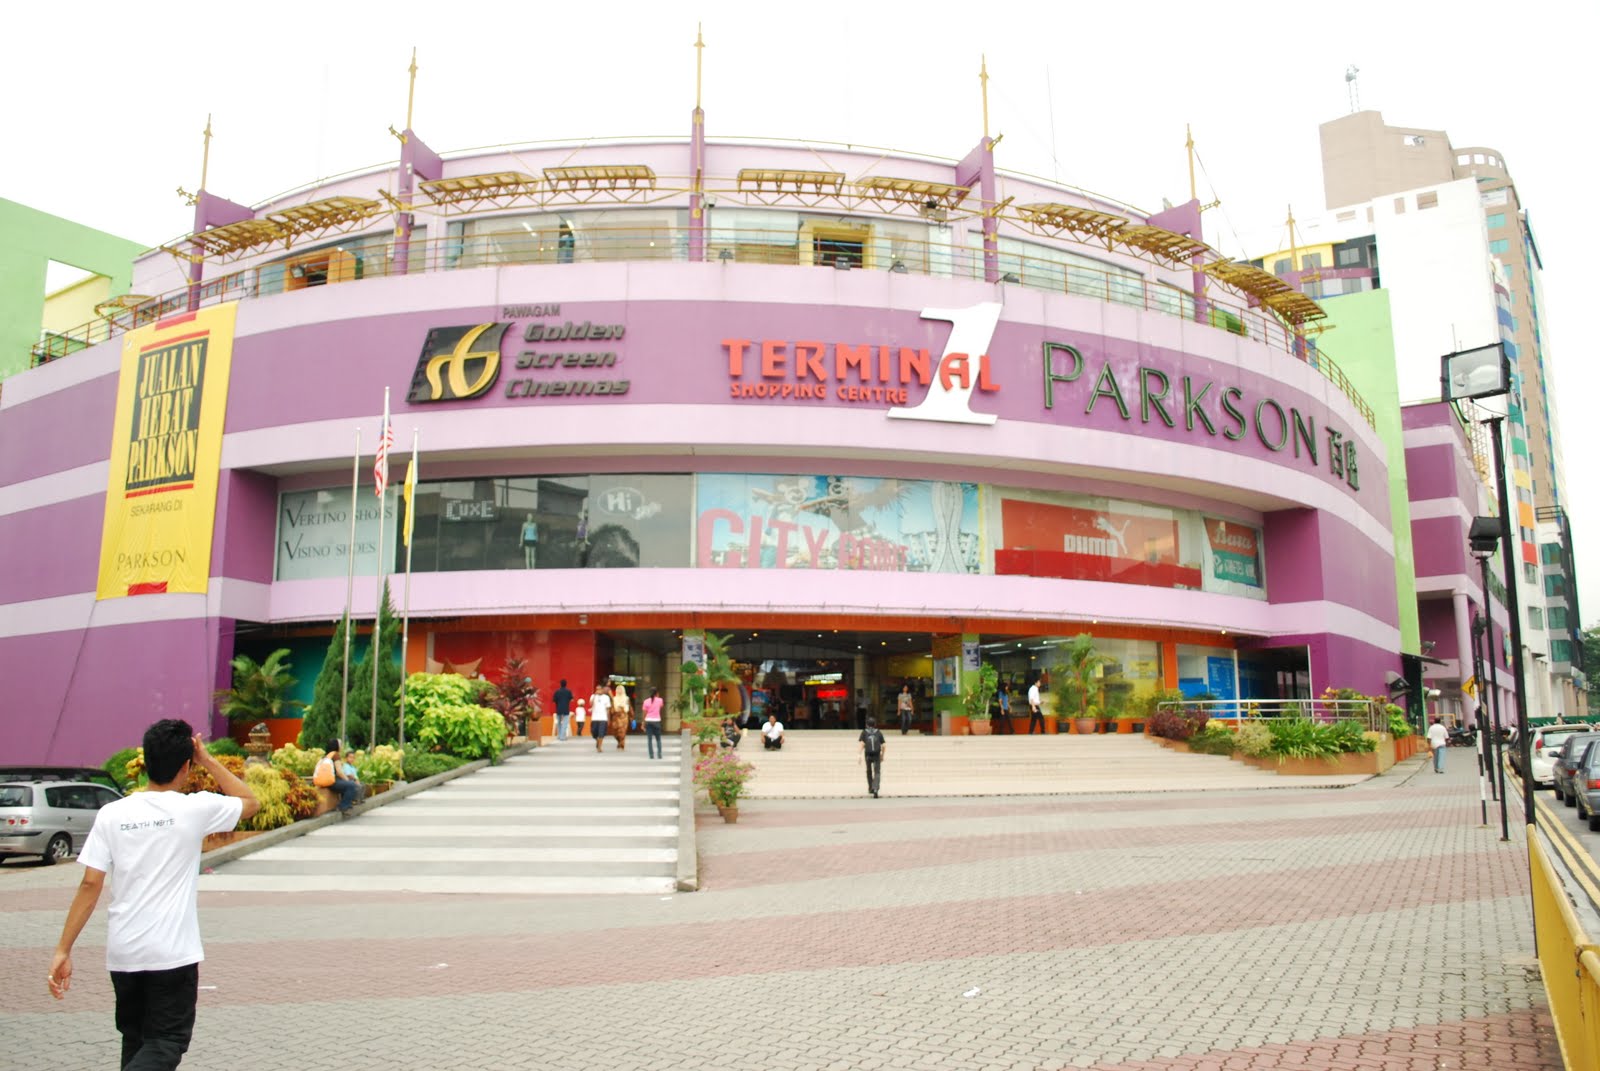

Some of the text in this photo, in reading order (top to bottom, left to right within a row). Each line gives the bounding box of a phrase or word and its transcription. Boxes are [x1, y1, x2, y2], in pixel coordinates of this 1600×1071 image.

[502, 304, 561, 319] PAWAGAM
[525, 321, 625, 342] Golden
[140, 343, 203, 400] JUALAN
[515, 350, 617, 369] Screen
[721, 338, 1001, 393] TERMINAL
[504, 378, 631, 399] Cinemas
[730, 382, 908, 405] SHOPPING CENTRE
[138, 386, 194, 442] HEBAT
[1042, 341, 1318, 466] PARKSON
[126, 428, 198, 485] PARKSON
[130, 499, 183, 518] SEKARANG DI
[286, 499, 346, 529] VERTINO
[284, 533, 330, 560] VISINO
[698, 508, 828, 568] CITY
[1064, 534, 1118, 558] PUMA
[117, 548, 186, 571] PARKSON
[120, 818, 175, 831] DEATH NOTE
